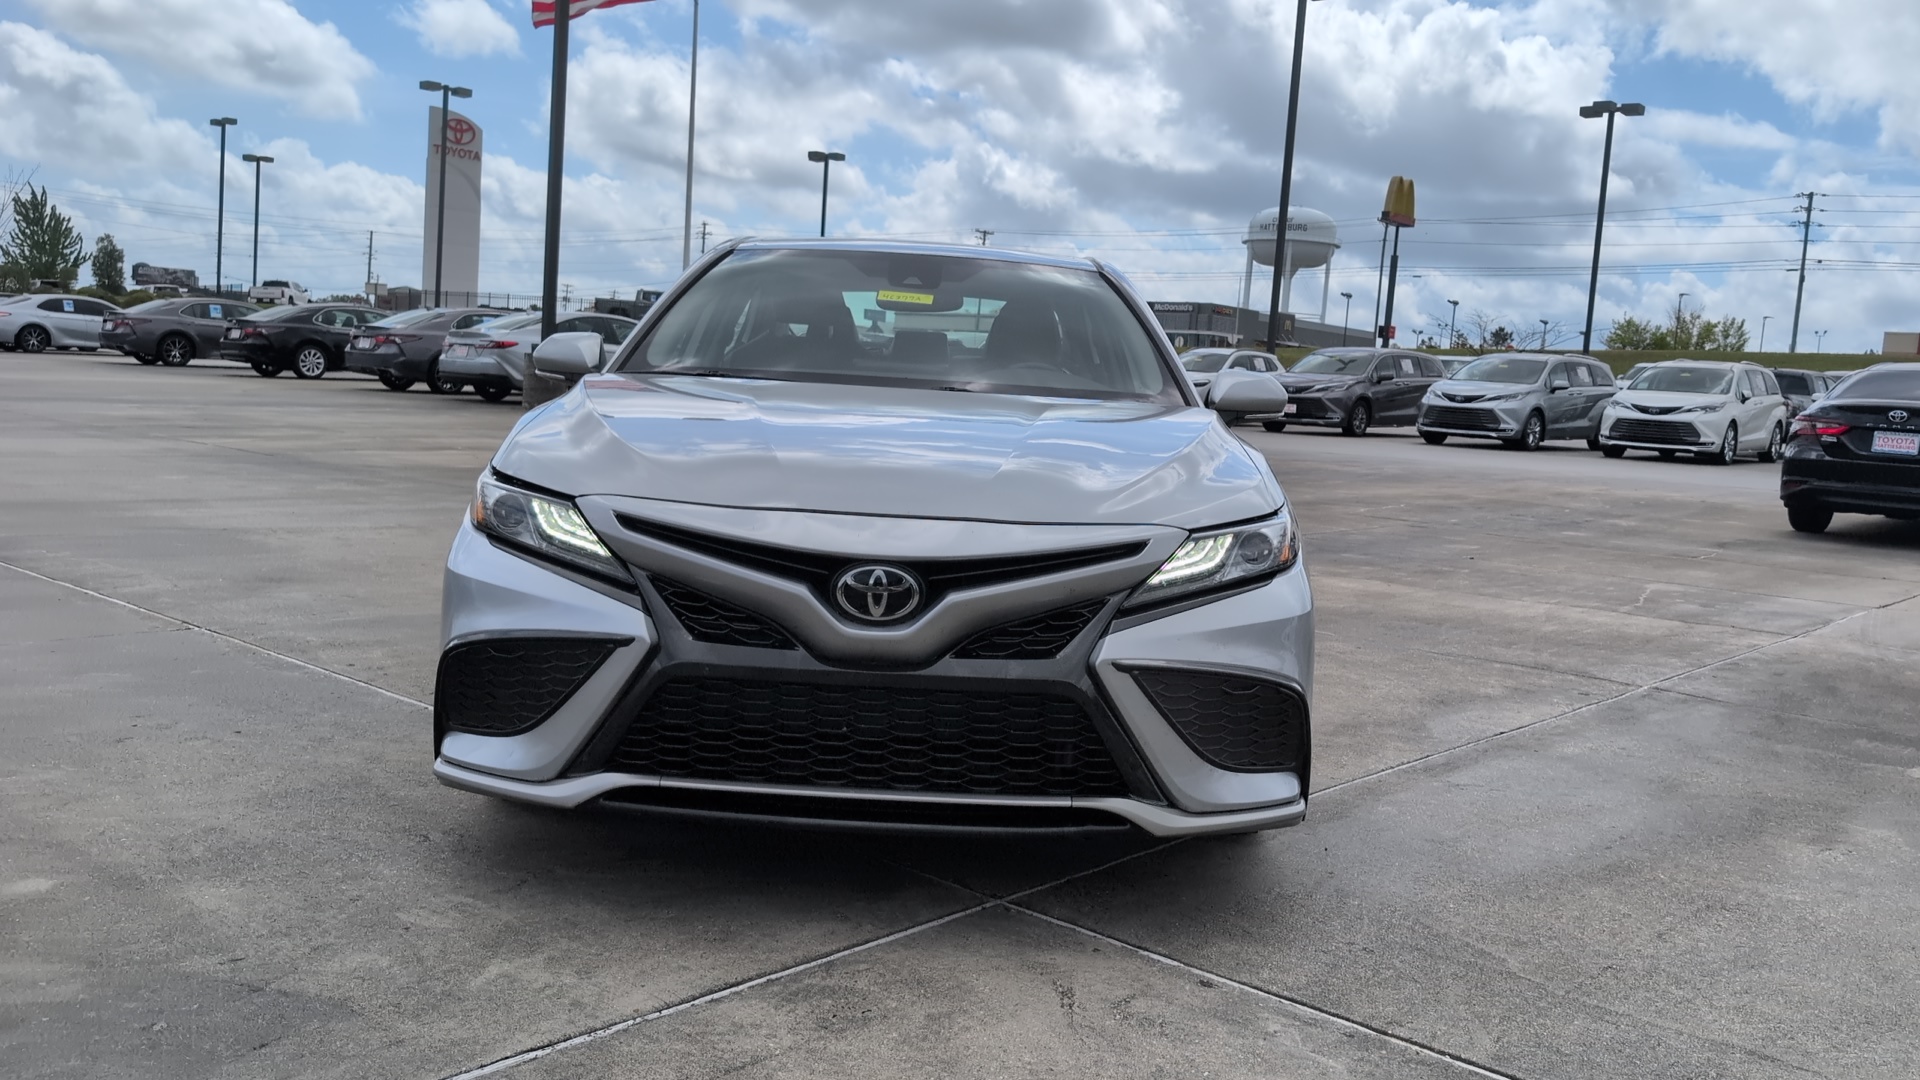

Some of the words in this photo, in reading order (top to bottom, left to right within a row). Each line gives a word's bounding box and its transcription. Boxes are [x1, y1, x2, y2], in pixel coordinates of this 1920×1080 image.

[1260, 223, 1308, 232] HATTBURG
[1153, 303, 1193, 312] McDonald's
[1876, 436, 1916, 446] TOYOTA
